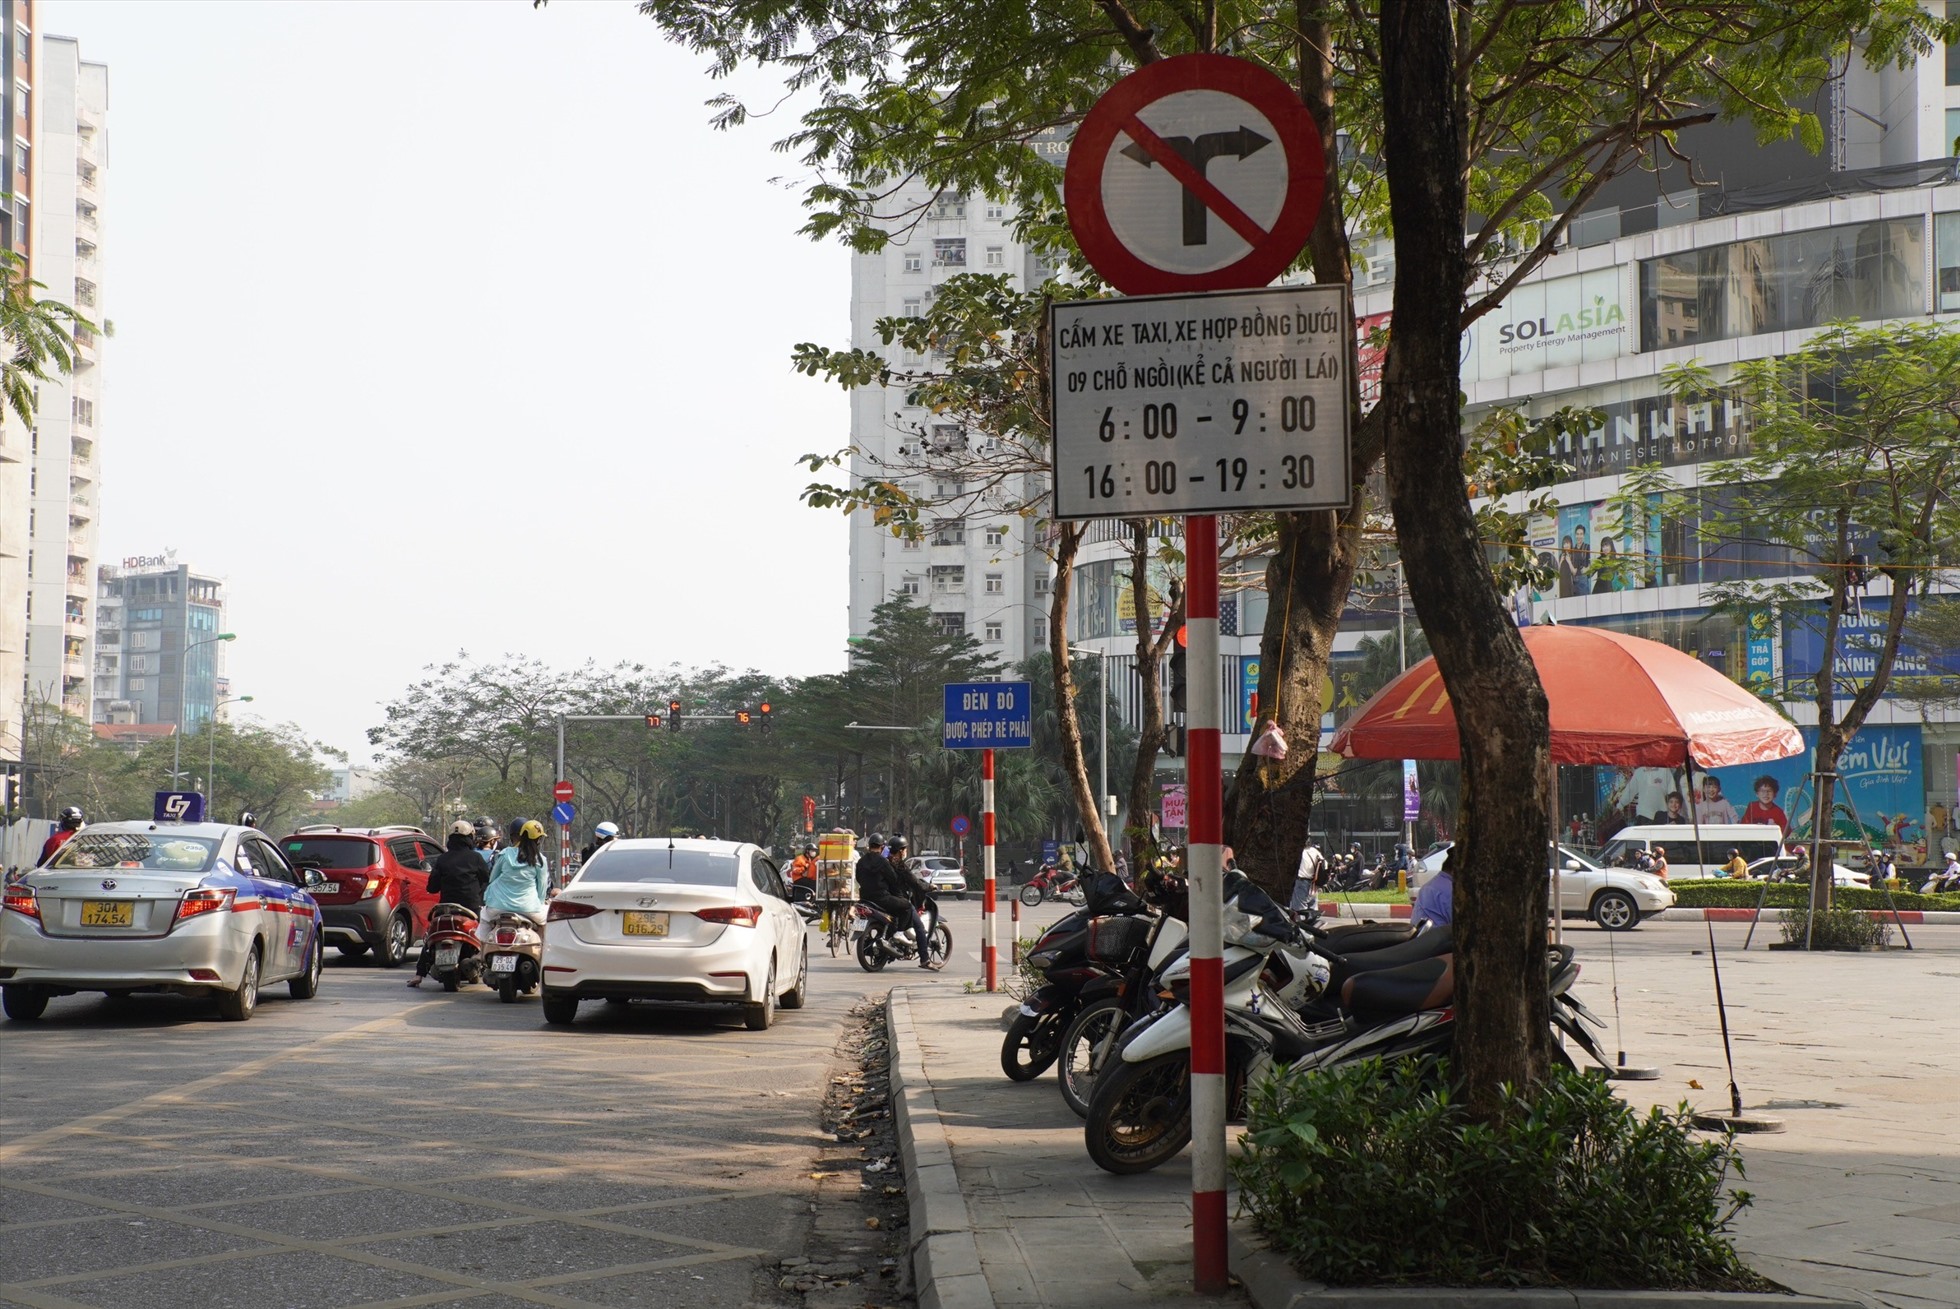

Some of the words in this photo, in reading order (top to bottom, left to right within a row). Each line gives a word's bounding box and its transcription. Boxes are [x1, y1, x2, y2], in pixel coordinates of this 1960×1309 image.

[1060, 318, 1096, 349] CẤM
[1102, 324, 1124, 346] XE
[1202, 316, 1238, 344] HỢP
[1241, 306, 1291, 338] ĐỒNG
[1296, 306, 1338, 334] DƯỚI
[1500, 342, 1535, 354] Property
[1536, 336, 1566, 348] Energy
[1567, 326, 1626, 342] Management
[1068, 371, 1087, 392] 09
[1094, 361, 1126, 392] CHỖ
[1212, 356, 1234, 384] CẢ
[1241, 354, 1296, 382] NGƯỜI
[1306, 352, 1338, 380] LÁI)
[122, 554, 166, 568] HDBank
[1751, 643, 1768, 654] TRẢ
[1752, 656, 1769, 666] GÓP
[963, 688, 988, 710] ĐÈN
[997, 686, 1014, 710] ĐỎ
[946, 720, 968, 742] ĐƯỢC
[972, 718, 993, 738] PHÉP
[996, 718, 1006, 738] RẼ
[1009, 715, 1030, 737] PHẢI
[166, 795, 191, 818] G7
[88, 914, 126, 924] 174.54
[96, 902, 118, 913] 30A
